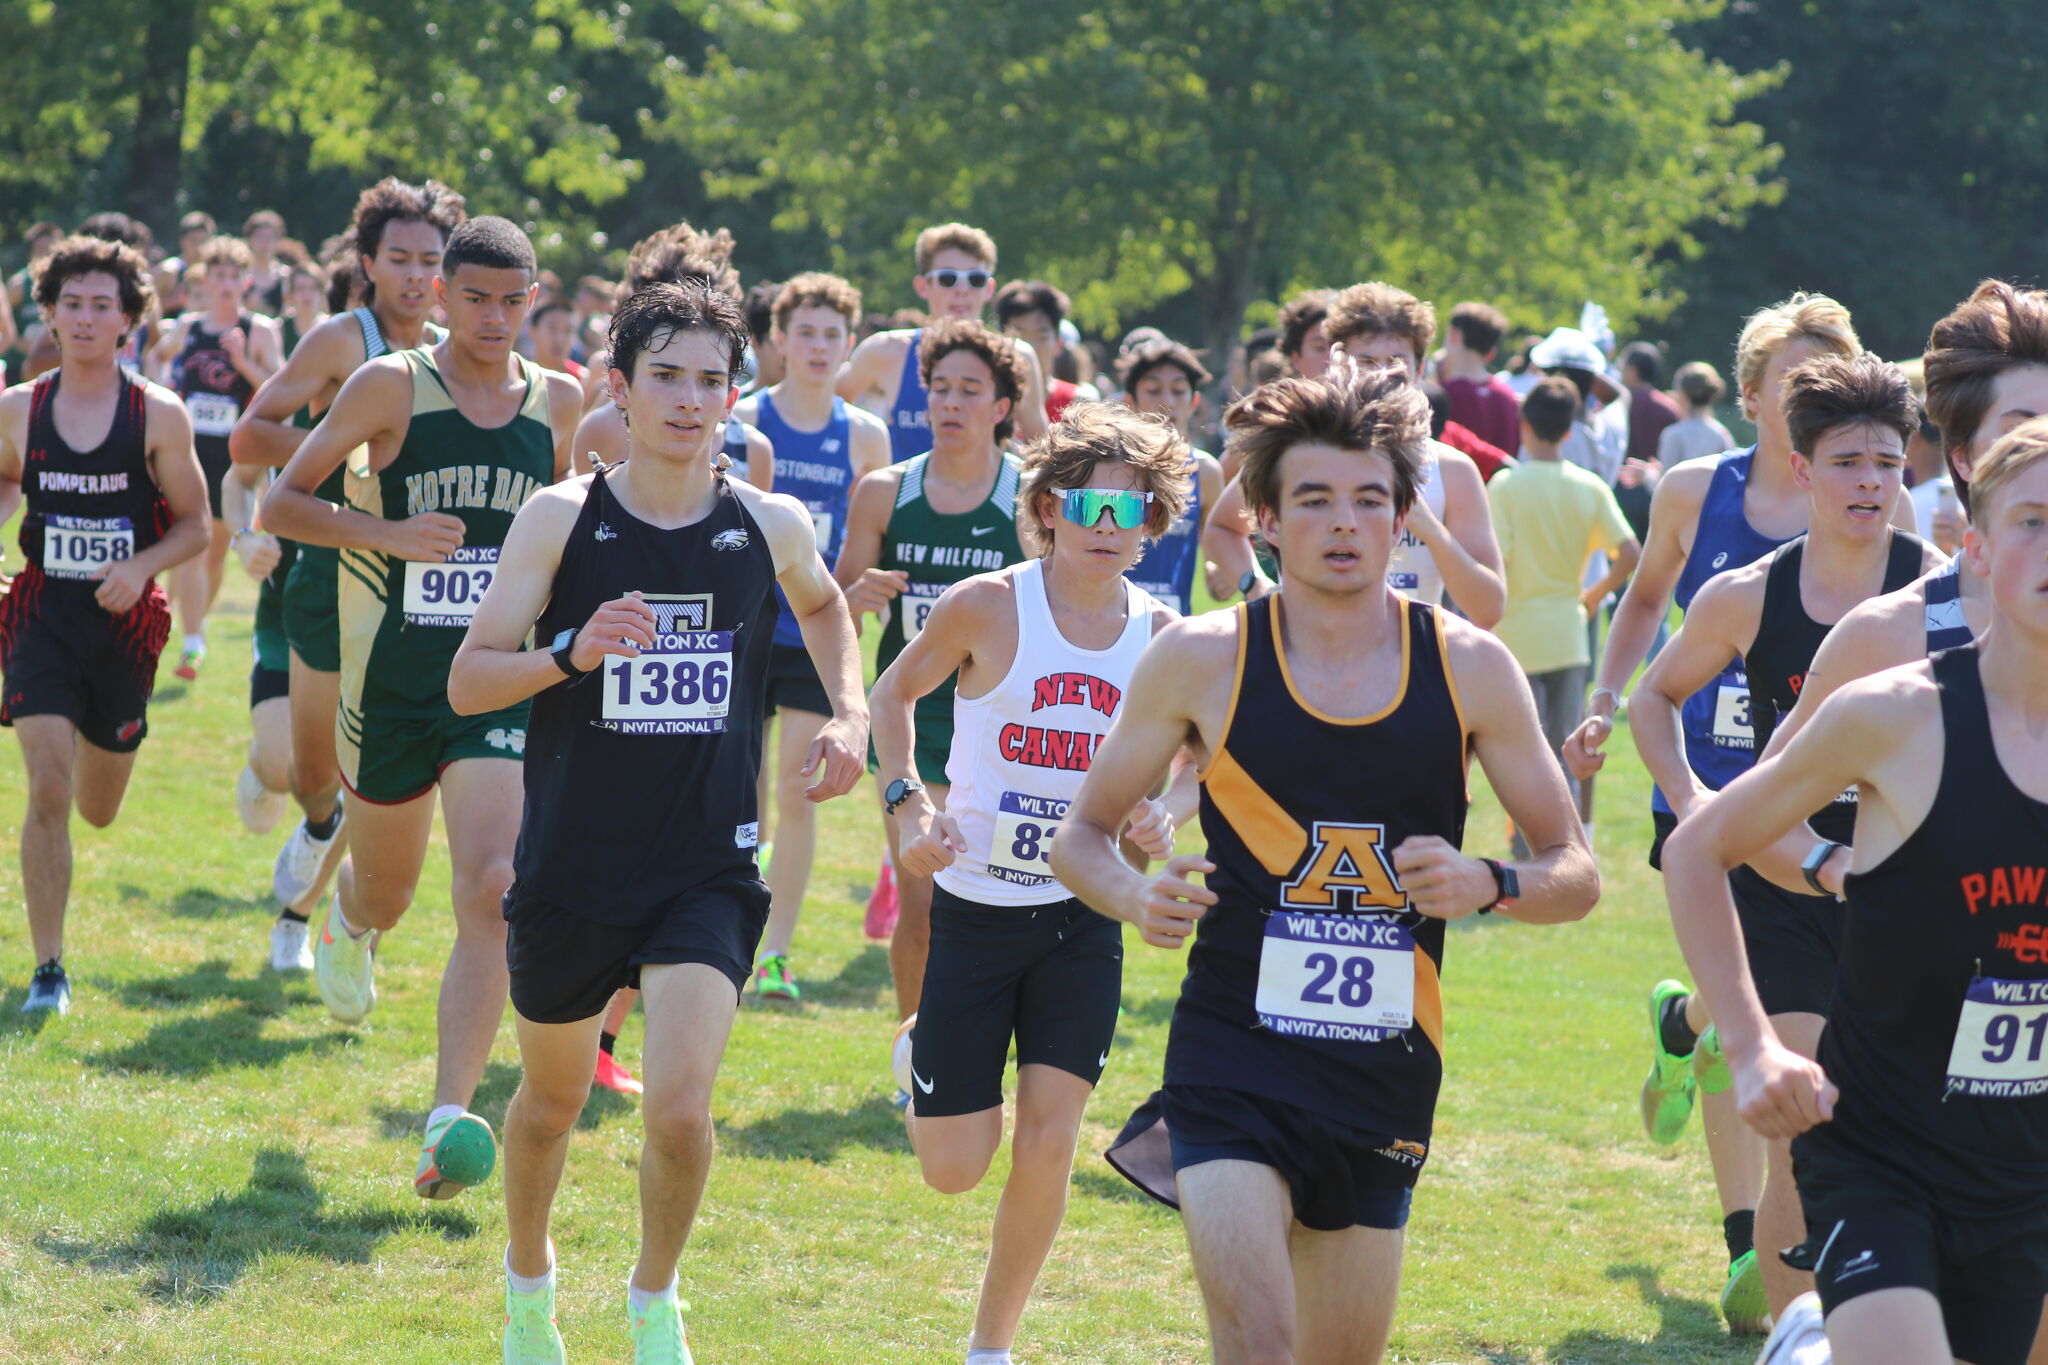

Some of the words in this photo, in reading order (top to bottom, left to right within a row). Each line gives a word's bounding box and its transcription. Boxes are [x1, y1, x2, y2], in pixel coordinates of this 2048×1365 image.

[39, 471, 129, 494] POMPERAUG
[405, 465, 489, 515] NOTRE
[56, 515, 101, 530] WILTON
[104, 518, 121, 530] XC
[50, 534, 129, 562] 1058
[479, 548, 497, 561] XC
[896, 543, 927, 563] NEW
[931, 546, 1004, 570] MILFORD
[422, 569, 493, 604] 903
[417, 614, 473, 627] INVITATIO
[916, 603, 931, 631] 8
[694, 633, 719, 649] XC
[611, 660, 729, 706] 1386
[1032, 672, 1121, 718] NEW
[1733, 695, 1752, 727] 3
[623, 721, 711, 733] INVITATIONAL
[999, 722, 1106, 772] CANA
[1018, 796, 1071, 817] WILTO
[1280, 821, 1410, 912] A
[1960, 866, 2048, 915] PAW
[1286, 916, 1367, 943] WILTON
[1370, 924, 1400, 946] XC
[1300, 952, 1375, 1008] 28
[1992, 981, 2048, 1002] WILTO
[1276, 1017, 1381, 1042] INVITATIONAL
[1969, 1079, 2048, 1097] INVITATIO
[1373, 1147, 1421, 1168] AMITY
